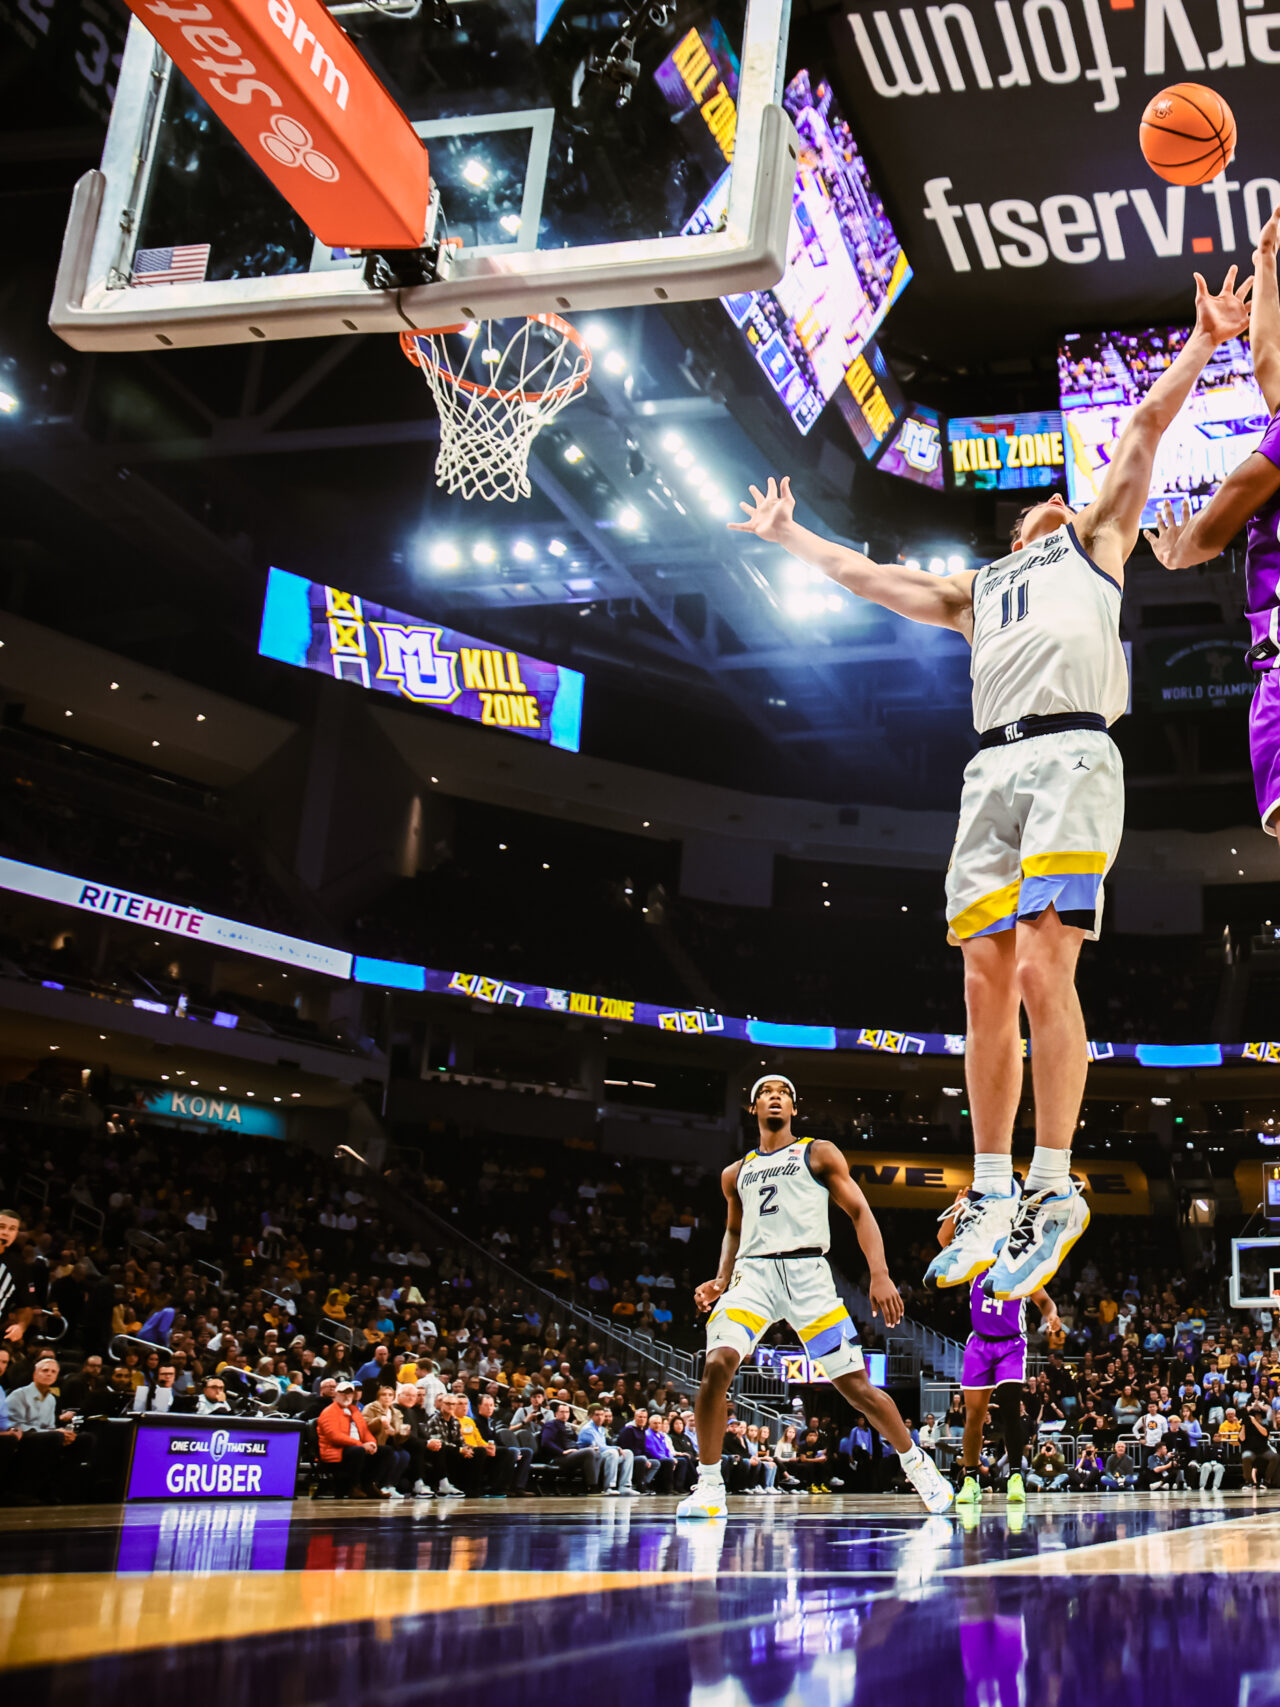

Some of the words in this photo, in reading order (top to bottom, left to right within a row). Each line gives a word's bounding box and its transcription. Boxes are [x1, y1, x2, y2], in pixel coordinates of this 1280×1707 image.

[147, 0, 283, 108] Stat
[267, 0, 350, 111] arm
[672, 26, 718, 105] KILL
[952, 437, 1002, 473] KILL
[1005, 431, 1065, 468] ZONE
[1000, 580, 1029, 629] 11
[374, 625, 458, 701] MU
[460, 647, 527, 692] KILL
[1161, 684, 1204, 701] WORLD
[1207, 682, 1255, 699] CHAMPI
[478, 692, 541, 728] ZONE
[78, 884, 204, 935] RITEHITE
[569, 991, 598, 1016] KILL
[599, 996, 635, 1022] ZONE
[170, 1091, 243, 1125] KONA
[741, 1162, 801, 1190] Marquette
[759, 1184, 780, 1217] 2
[981, 1297, 1004, 1316] 24
[171, 1441, 189, 1452] ONE
[189, 1441, 209, 1452] CALL
[252, 1443, 266, 1454] ALL
[166, 1463, 262, 1493] GRUBER
